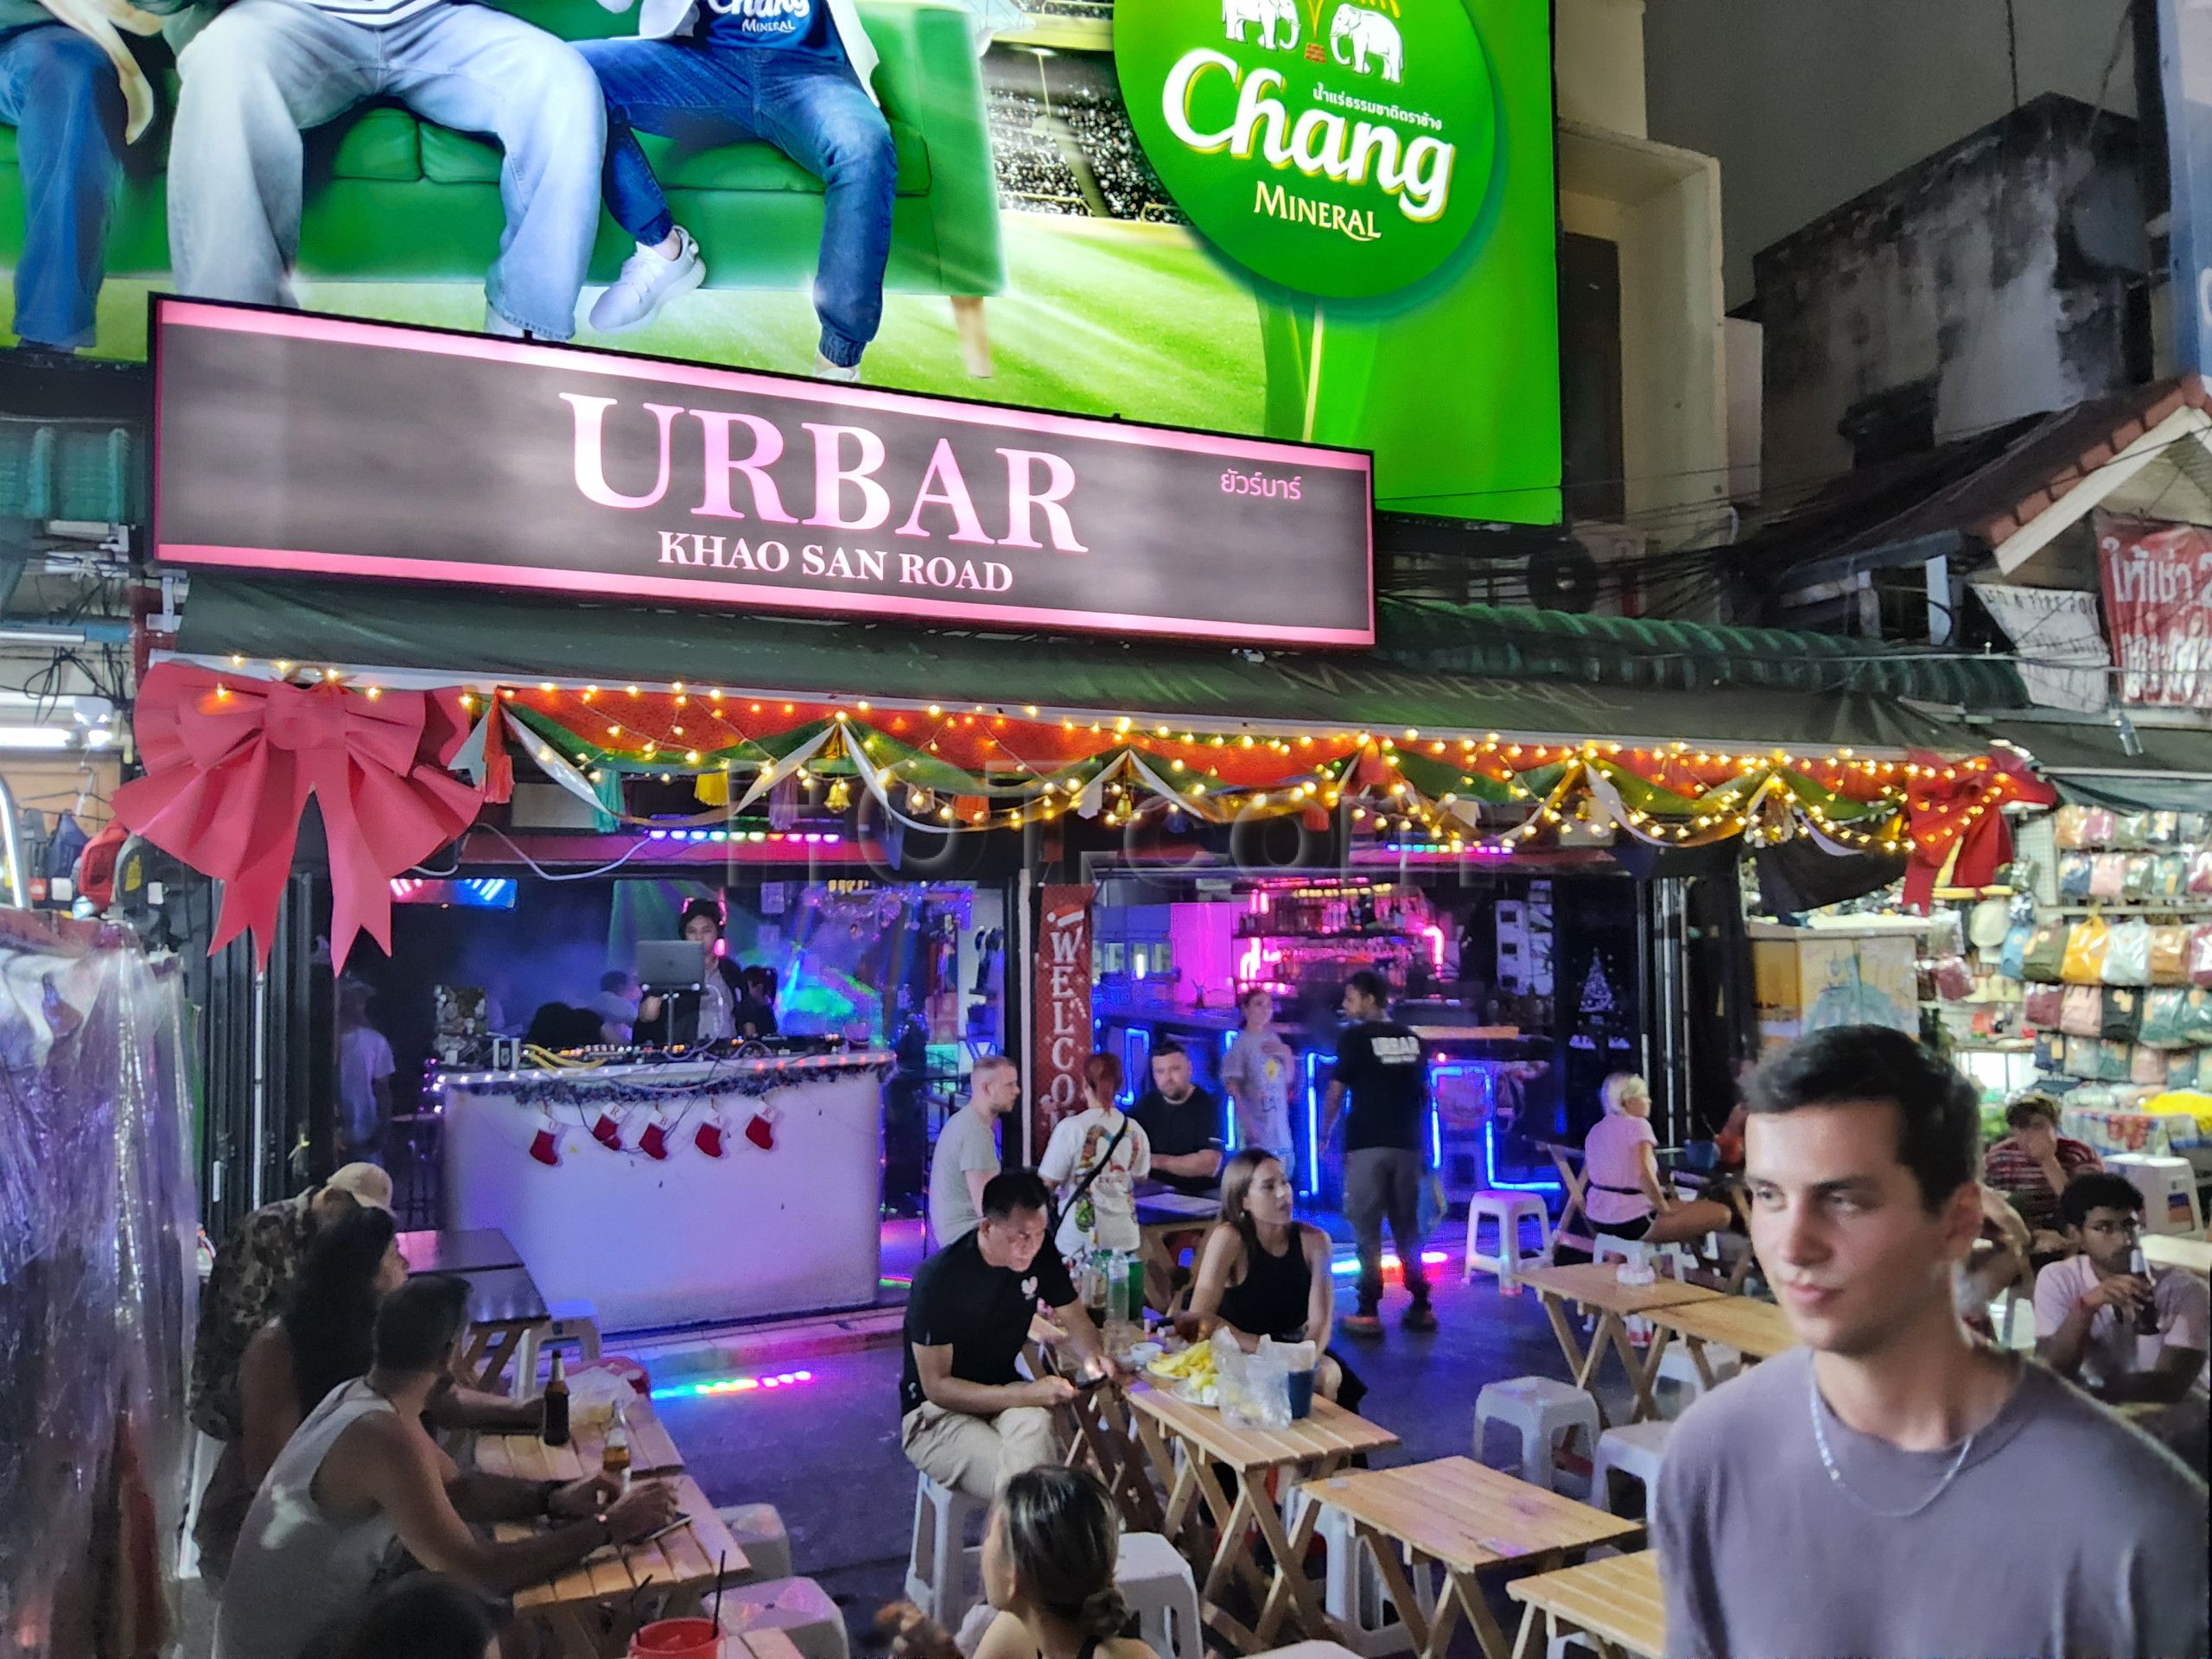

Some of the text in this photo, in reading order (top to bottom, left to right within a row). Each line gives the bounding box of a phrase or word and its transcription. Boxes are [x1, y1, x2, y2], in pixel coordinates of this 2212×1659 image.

[741, 18, 796, 33] MINERAL
[1161, 48, 1458, 223] Chang
[1254, 180, 1382, 242] MINERAL
[558, 391, 1089, 554] URBAR
[1219, 467, 1302, 500] ยัวร์บาร์
[658, 530, 1014, 593] KHAO SAN ROAD
[1044, 926, 1084, 1125] WELCO
